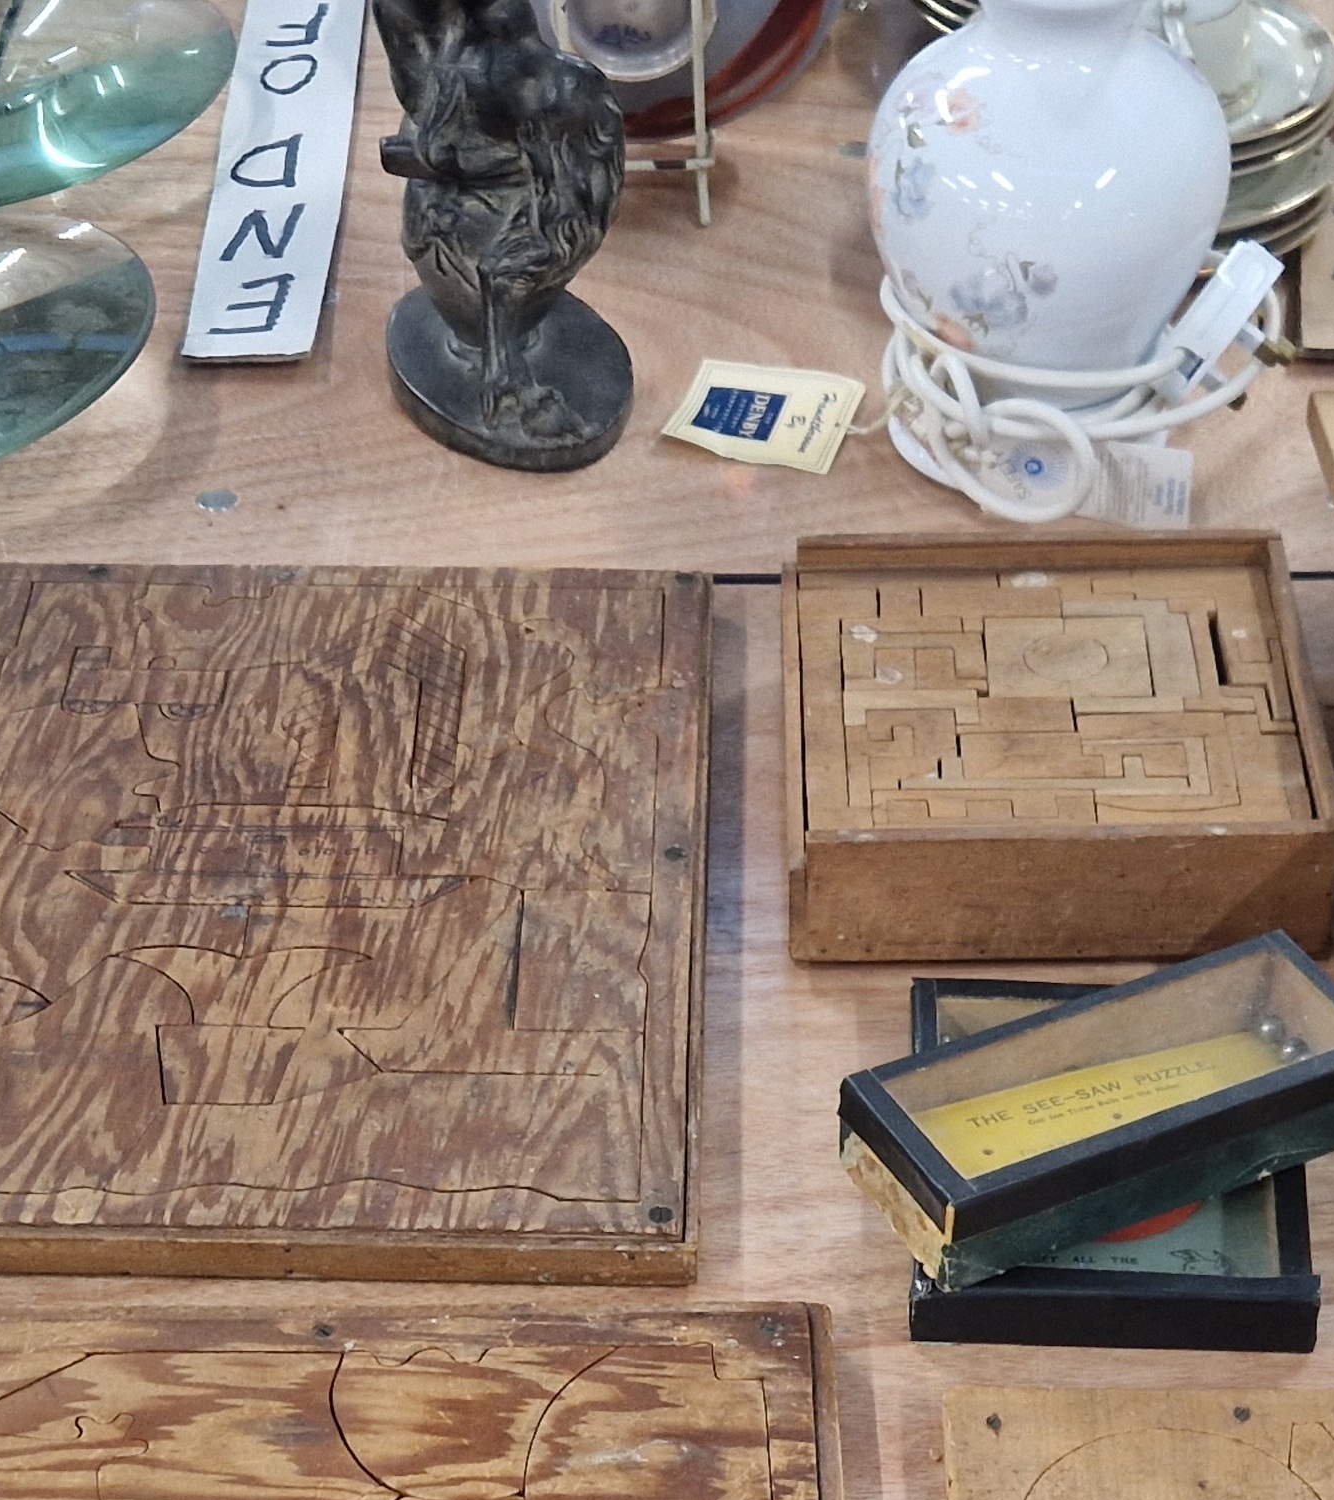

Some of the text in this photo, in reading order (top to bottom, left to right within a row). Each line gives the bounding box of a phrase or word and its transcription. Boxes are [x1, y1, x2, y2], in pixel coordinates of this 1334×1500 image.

[206, 2, 329, 335] END OF
[738, 393, 772, 440] DENBY
[967, 1109, 1014, 1129] THE
[1022, 1081, 1122, 1115] SEE-SAW
